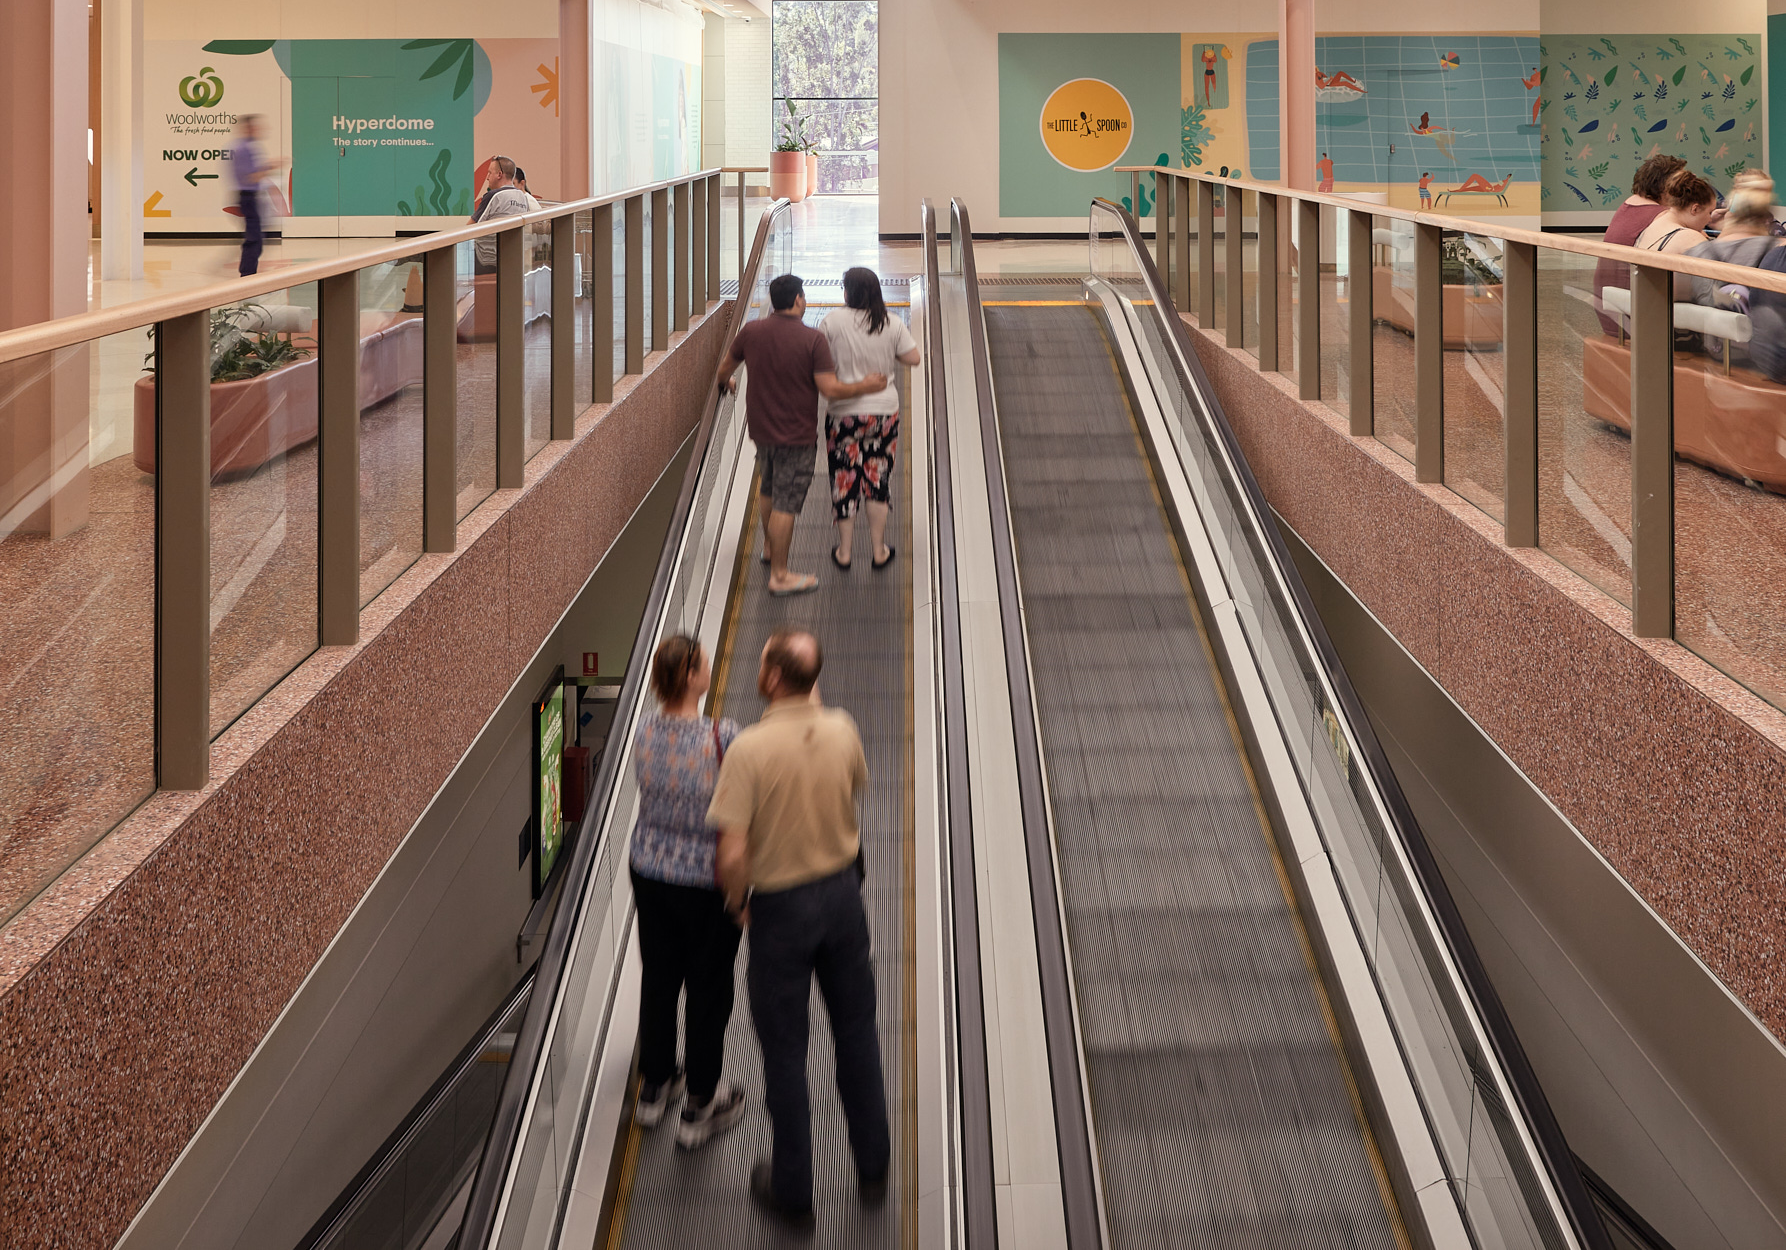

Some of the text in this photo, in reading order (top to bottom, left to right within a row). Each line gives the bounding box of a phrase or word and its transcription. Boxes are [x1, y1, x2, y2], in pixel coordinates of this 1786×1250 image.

[165, 111, 237, 125] Woolworths
[170, 125, 231, 136] The fresh food people
[332, 115, 435, 134] Hyperdome
[1055, 119, 1078, 131] LITTLE
[1096, 119, 1120, 131] SPOON
[332, 137, 435, 148] The story continues...
[163, 149, 199, 161] NOW
